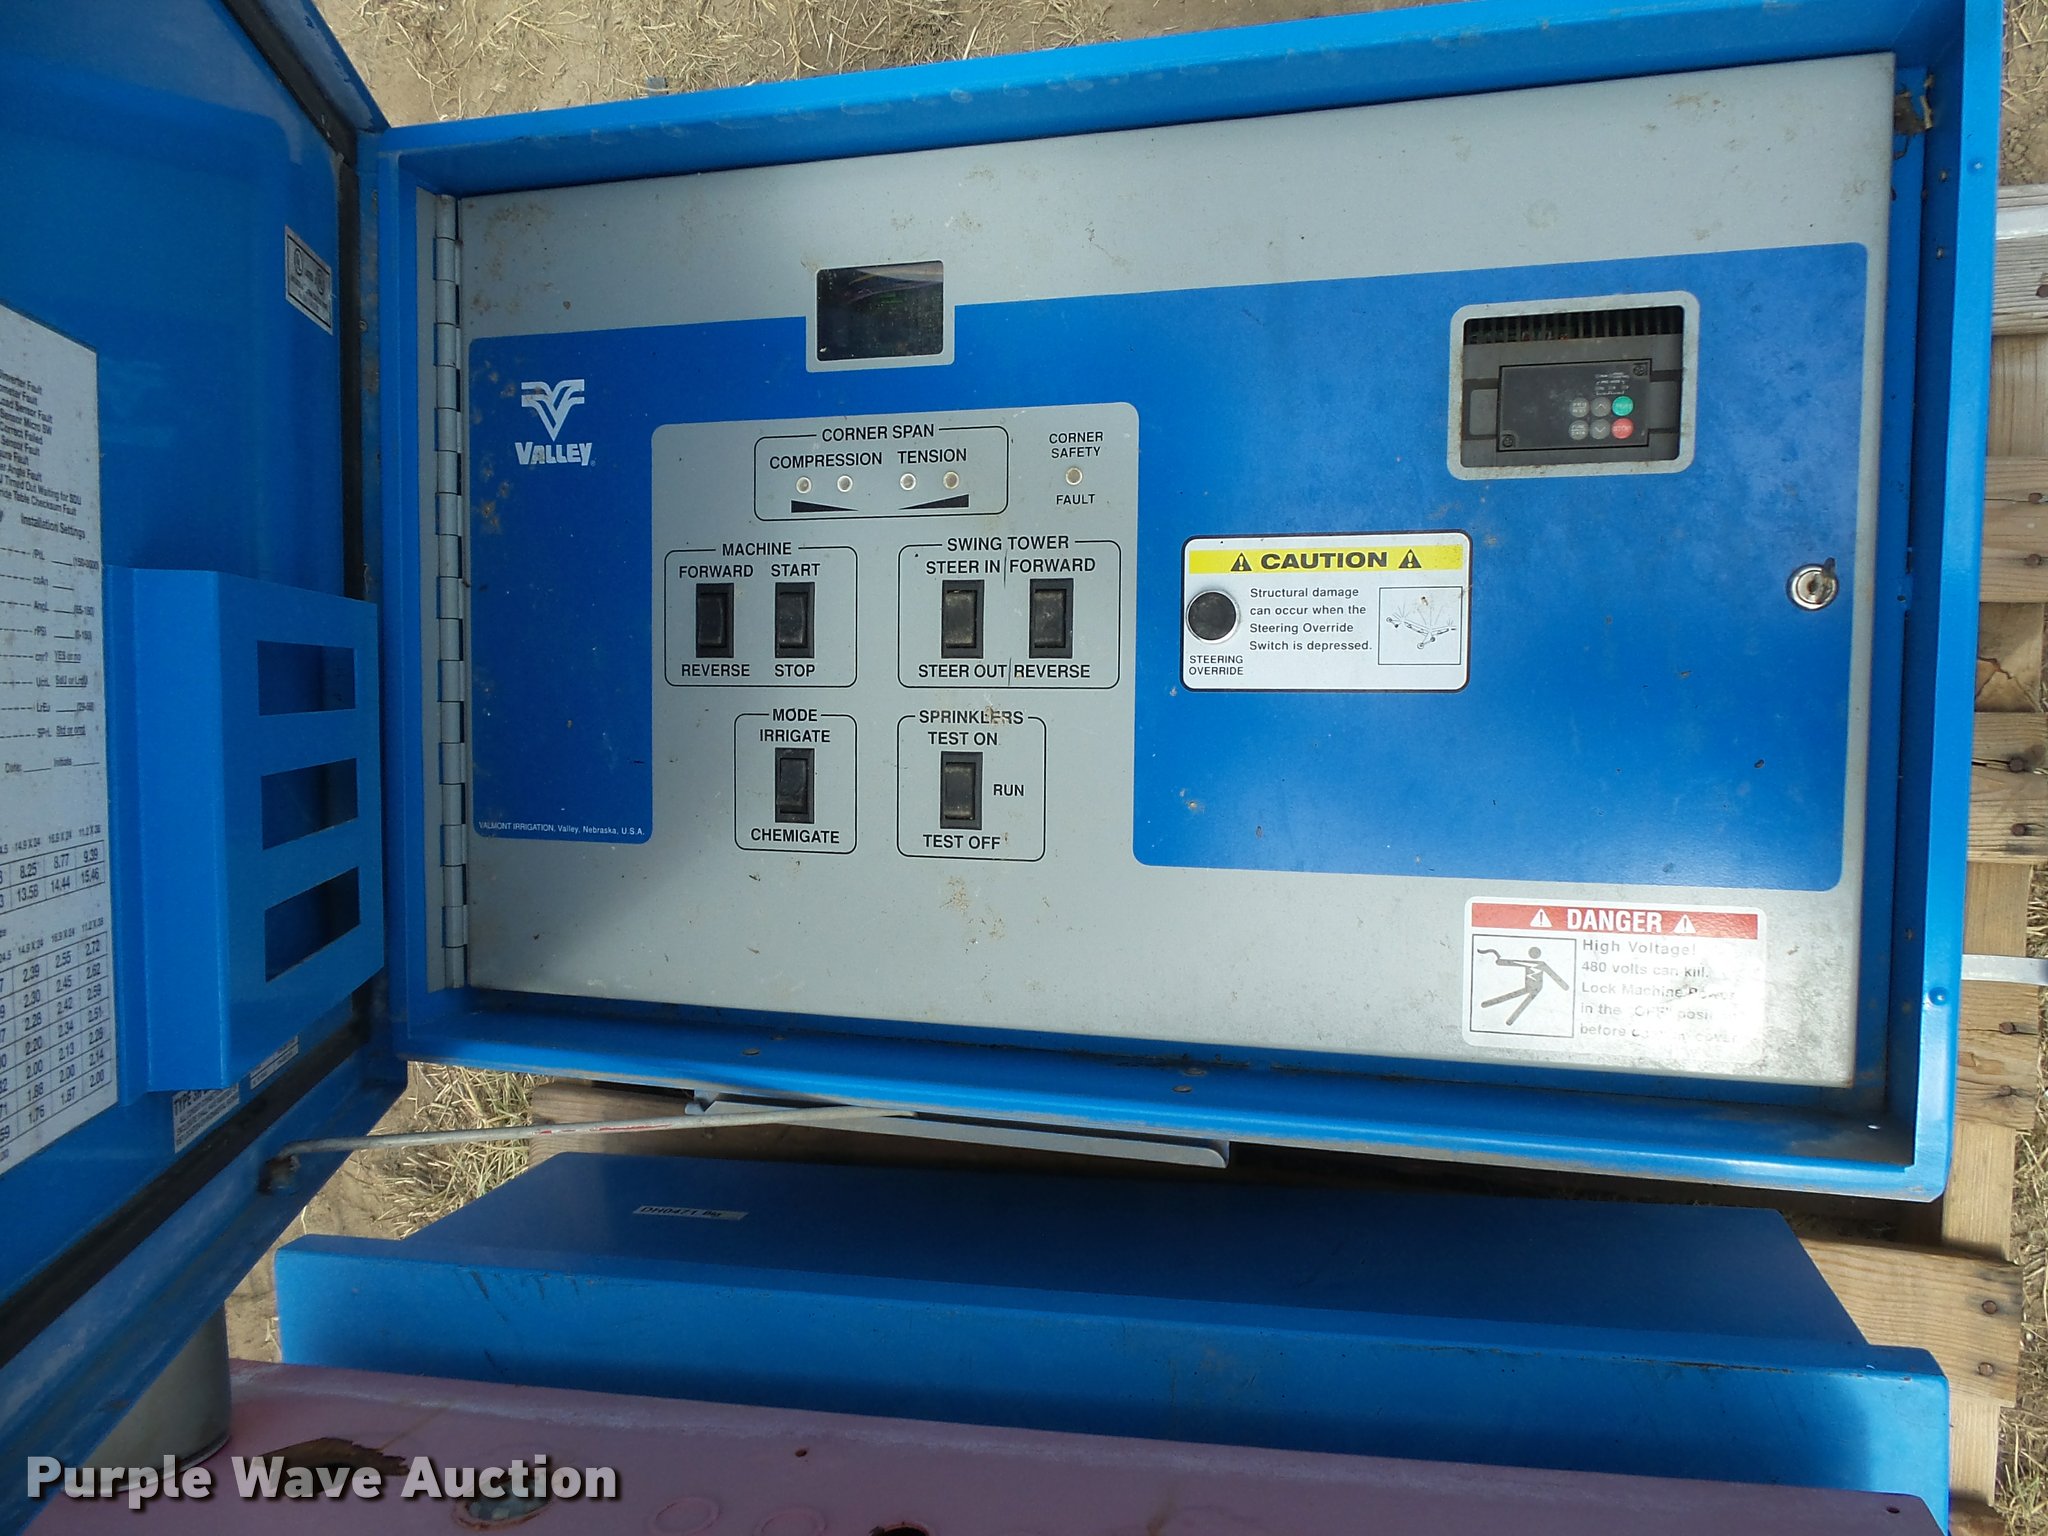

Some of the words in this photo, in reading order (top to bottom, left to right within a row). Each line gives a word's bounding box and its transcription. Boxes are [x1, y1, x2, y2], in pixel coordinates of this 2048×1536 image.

[821, 427, 888, 442] CORNER
[892, 424, 934, 439] SPAN
[1049, 431, 1104, 444] CORNER
[515, 442, 592, 466] VALLEY
[769, 451, 883, 469] COMPRESSION
[897, 448, 967, 464] TENSION
[1051, 446, 1101, 459] SAFETY
[1056, 493, 1096, 505] FAULT
[21, 513, 59, 533] Installation
[60, 522, 86, 540] Settings
[722, 543, 792, 557] MACHINE
[947, 536, 1002, 551] SWING
[1007, 535, 1069, 550] TOWER
[926, 560, 981, 575] STEER
[984, 559, 1001, 574] IN
[1009, 558, 1096, 573] FORWARD
[1260, 551, 1387, 569] CAUTION
[679, 564, 754, 579] FORWARD
[771, 562, 821, 577] START
[1250, 588, 1308, 598] Structural
[1312, 588, 1359, 600] damage
[1250, 607, 1271, 615] can
[1275, 607, 1309, 615] occur
[1312, 605, 1344, 615] when
[1348, 605, 1366, 614] the
[1250, 623, 1299, 635] Steering
[1303, 623, 1354, 633] Override
[1249, 641, 1290, 650] Switch
[1293, 641, 1303, 650] is
[1307, 641, 1372, 652] depressed.
[1189, 655, 1243, 664] STEERING
[681, 664, 750, 677] REVERSE
[774, 664, 815, 677] STOP
[918, 664, 970, 678] STEER
[974, 664, 1007, 678] OUT
[1013, 664, 1091, 678] REVERSE
[1189, 666, 1244, 675] OVERRIDE
[772, 708, 818, 722] MODE
[919, 710, 1024, 725] SPRINKLERS
[759, 728, 831, 743] IRRIGATE
[928, 731, 969, 745] TEST
[973, 731, 998, 746] ON
[993, 784, 1024, 796] RUN
[479, 821, 512, 830] VALMONT
[558, 825, 581, 834] Valley,
[583, 825, 619, 836] Nebraska,
[750, 828, 840, 844] CHEMIGATE
[923, 834, 964, 848] TEST
[968, 834, 1001, 849] OFF
[20, 862, 38, 879] 8.25
[53, 853, 70, 869] 8.77
[83, 848, 99, 863] 9.39
[17, 884, 39, 902] 13.58
[51, 875, 71, 893] 14.44
[81, 867, 99, 883] 15.46
[1567, 909, 1662, 933] DANGER
[1583, 939, 1620, 954] High
[1628, 941, 1696, 957] Voltage!
[22, 963, 40, 983] 2.39
[55, 950, 72, 969] 2.55
[85, 939, 101, 957] 2.72
[1582, 961, 1607, 973] 480
[1612, 963, 1647, 975] volts
[23, 988, 41, 1008] 2.30
[56, 974, 72, 993] 2.45
[86, 962, 101, 980] 2.62
[1582, 982, 1616, 994] Lock
[1622, 984, 1682, 997] Machine
[57, 996, 73, 1015] 2.42
[1581, 1003, 1593, 1014] in
[1598, 1004, 1622, 1015] the
[25, 1036, 42, 1056] 2.20
[58, 1019, 74, 1038] 2.34
[87, 1005, 103, 1023] 2.51
[1580, 1024, 1626, 1037] before
[26, 1059, 43, 1080] 2.00
[58, 1041, 75, 1062] 2.13
[59, 1063, 76, 1083] 2.00
[89, 1047, 105, 1067] 2.14
[28, 1104, 45, 1124] 1.76
[60, 1086, 77, 1106] 1.87
[90, 1068, 105, 1088] 2.00
